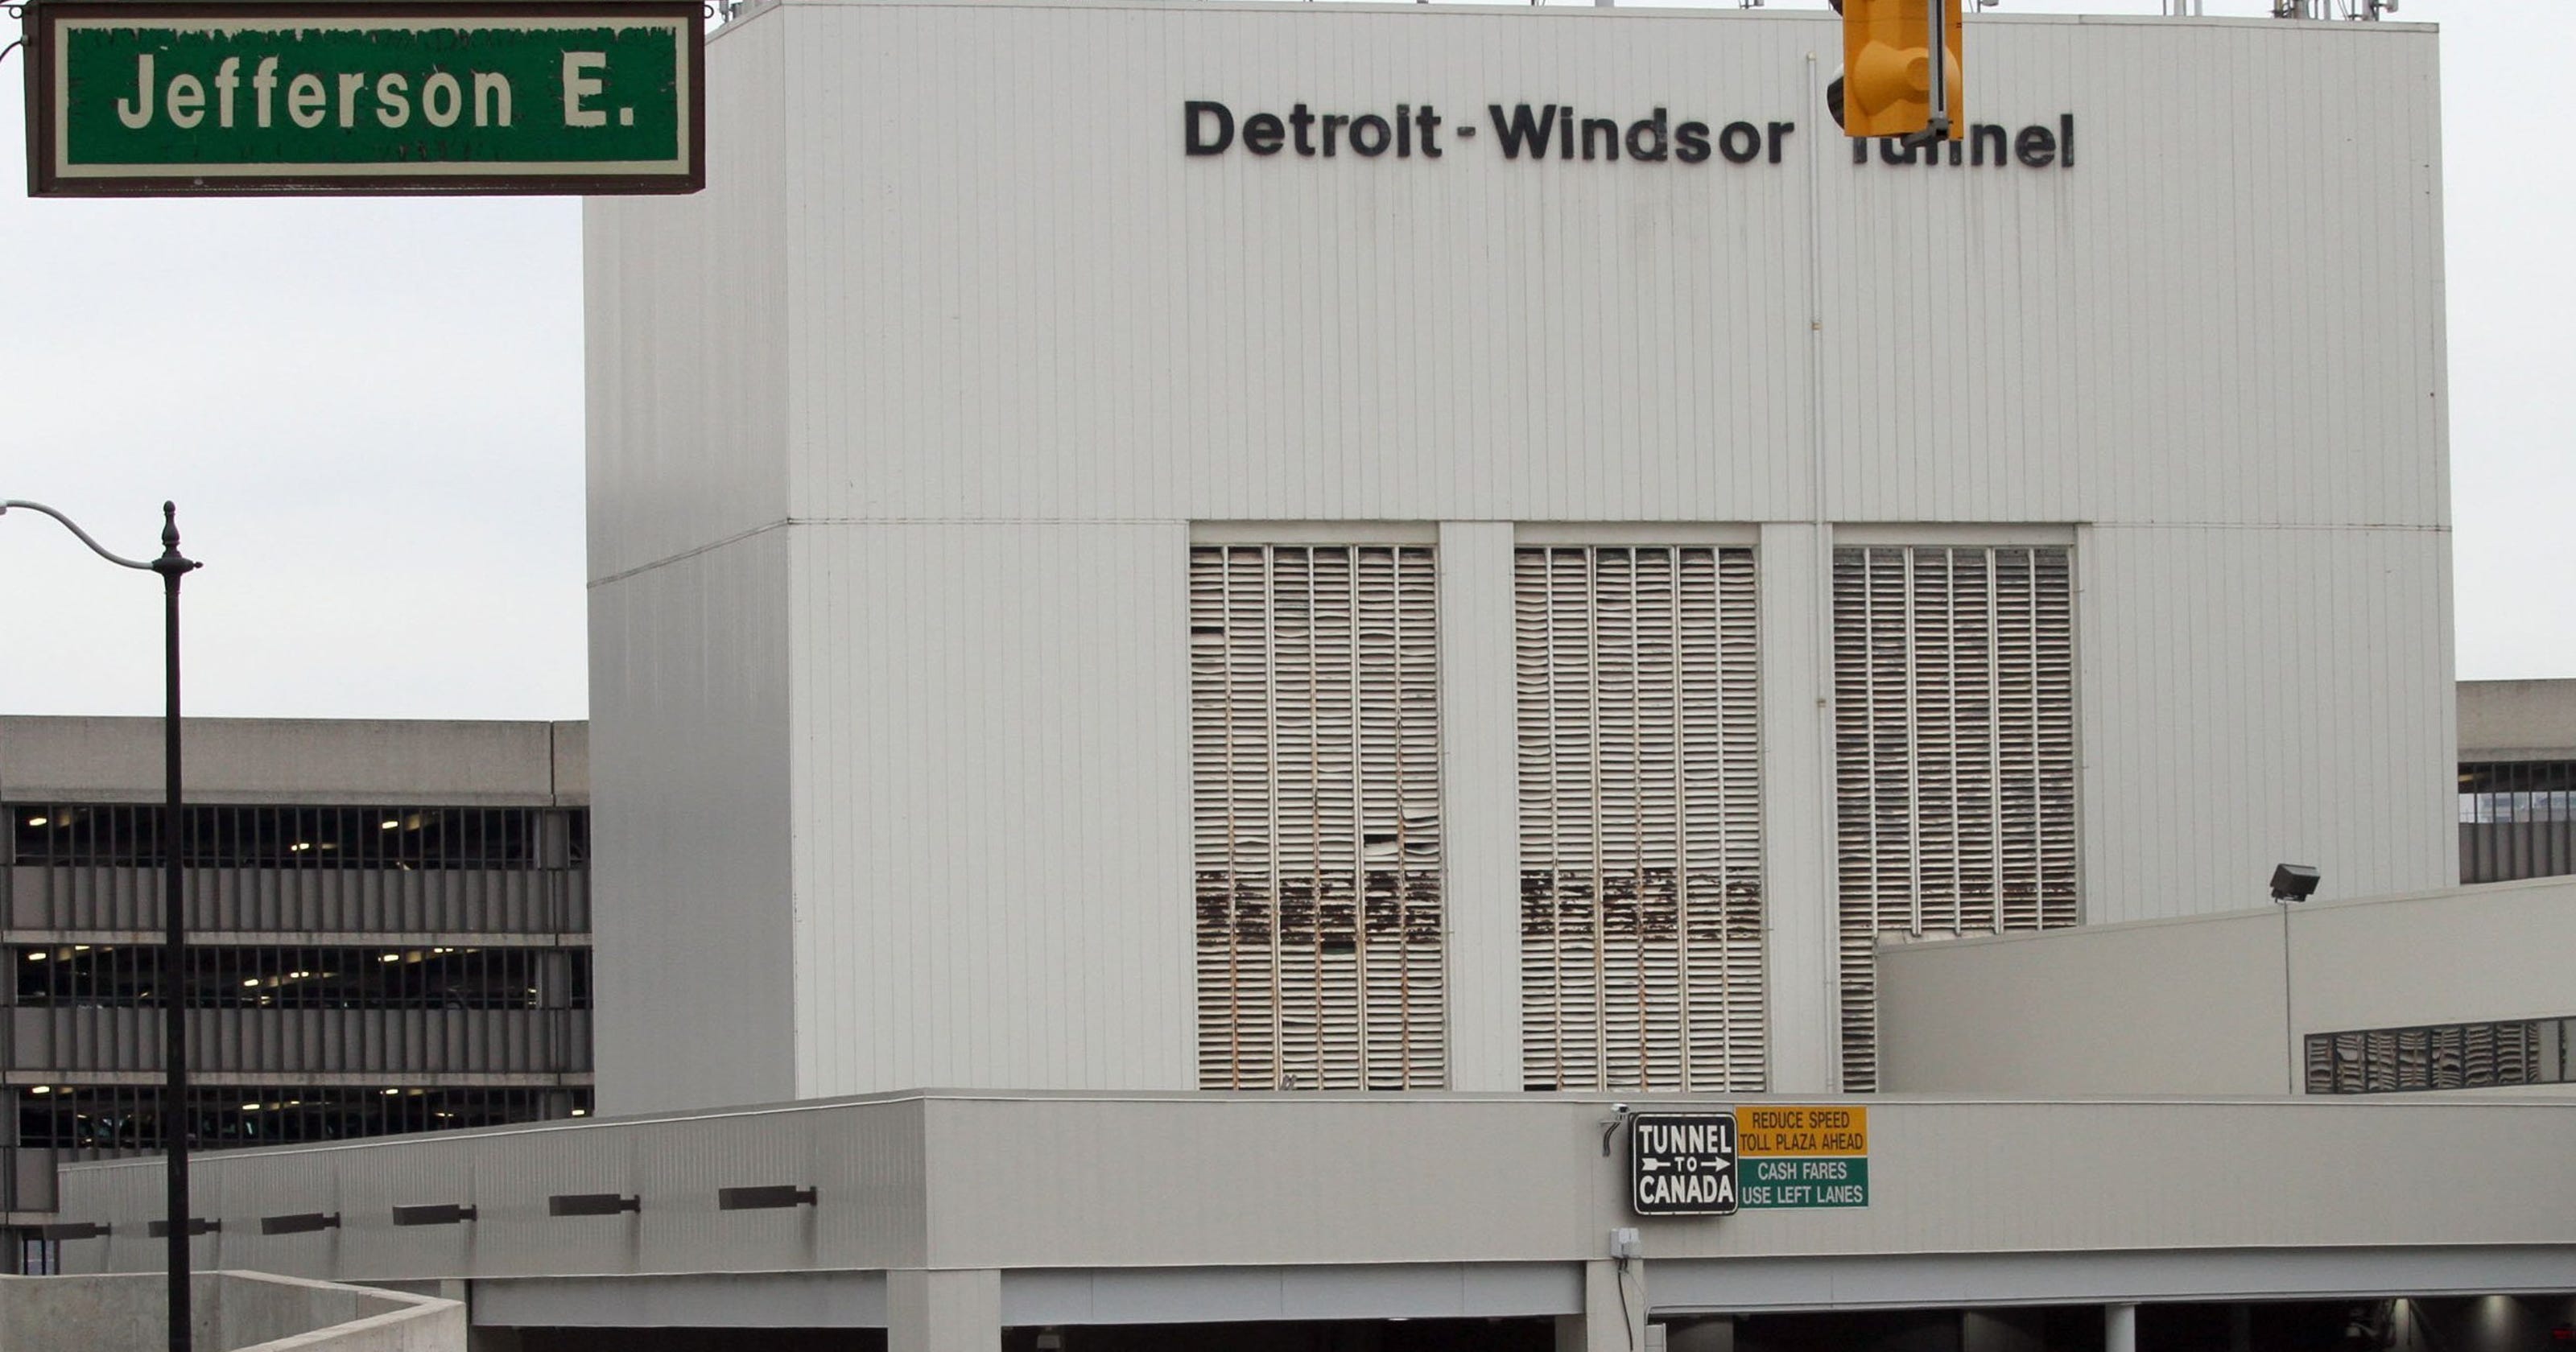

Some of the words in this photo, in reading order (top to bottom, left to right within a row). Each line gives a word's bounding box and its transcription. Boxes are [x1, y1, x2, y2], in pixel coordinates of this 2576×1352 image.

[118, 54, 511, 129] Jefferson
[563, 52, 634, 127] E.
[1752, 1111, 1803, 1128] REDUCE
[1809, 1111, 1850, 1128] SPEED
[1639, 1125, 1732, 1154] TUNNEL
[1740, 1133, 1771, 1151] TOLL
[1776, 1133, 1817, 1151] PLAZA
[1822, 1132, 1864, 1151] AHEAD
[1674, 1156, 1698, 1173] TO
[1758, 1162, 1797, 1181] CASH
[1802, 1161, 1847, 1180] FARES
[1639, 1175, 1734, 1204] CANADA
[1743, 1186, 1772, 1204] USE
[1777, 1186, 1811, 1204] LEFT
[1817, 1185, 1863, 1203] LANES
